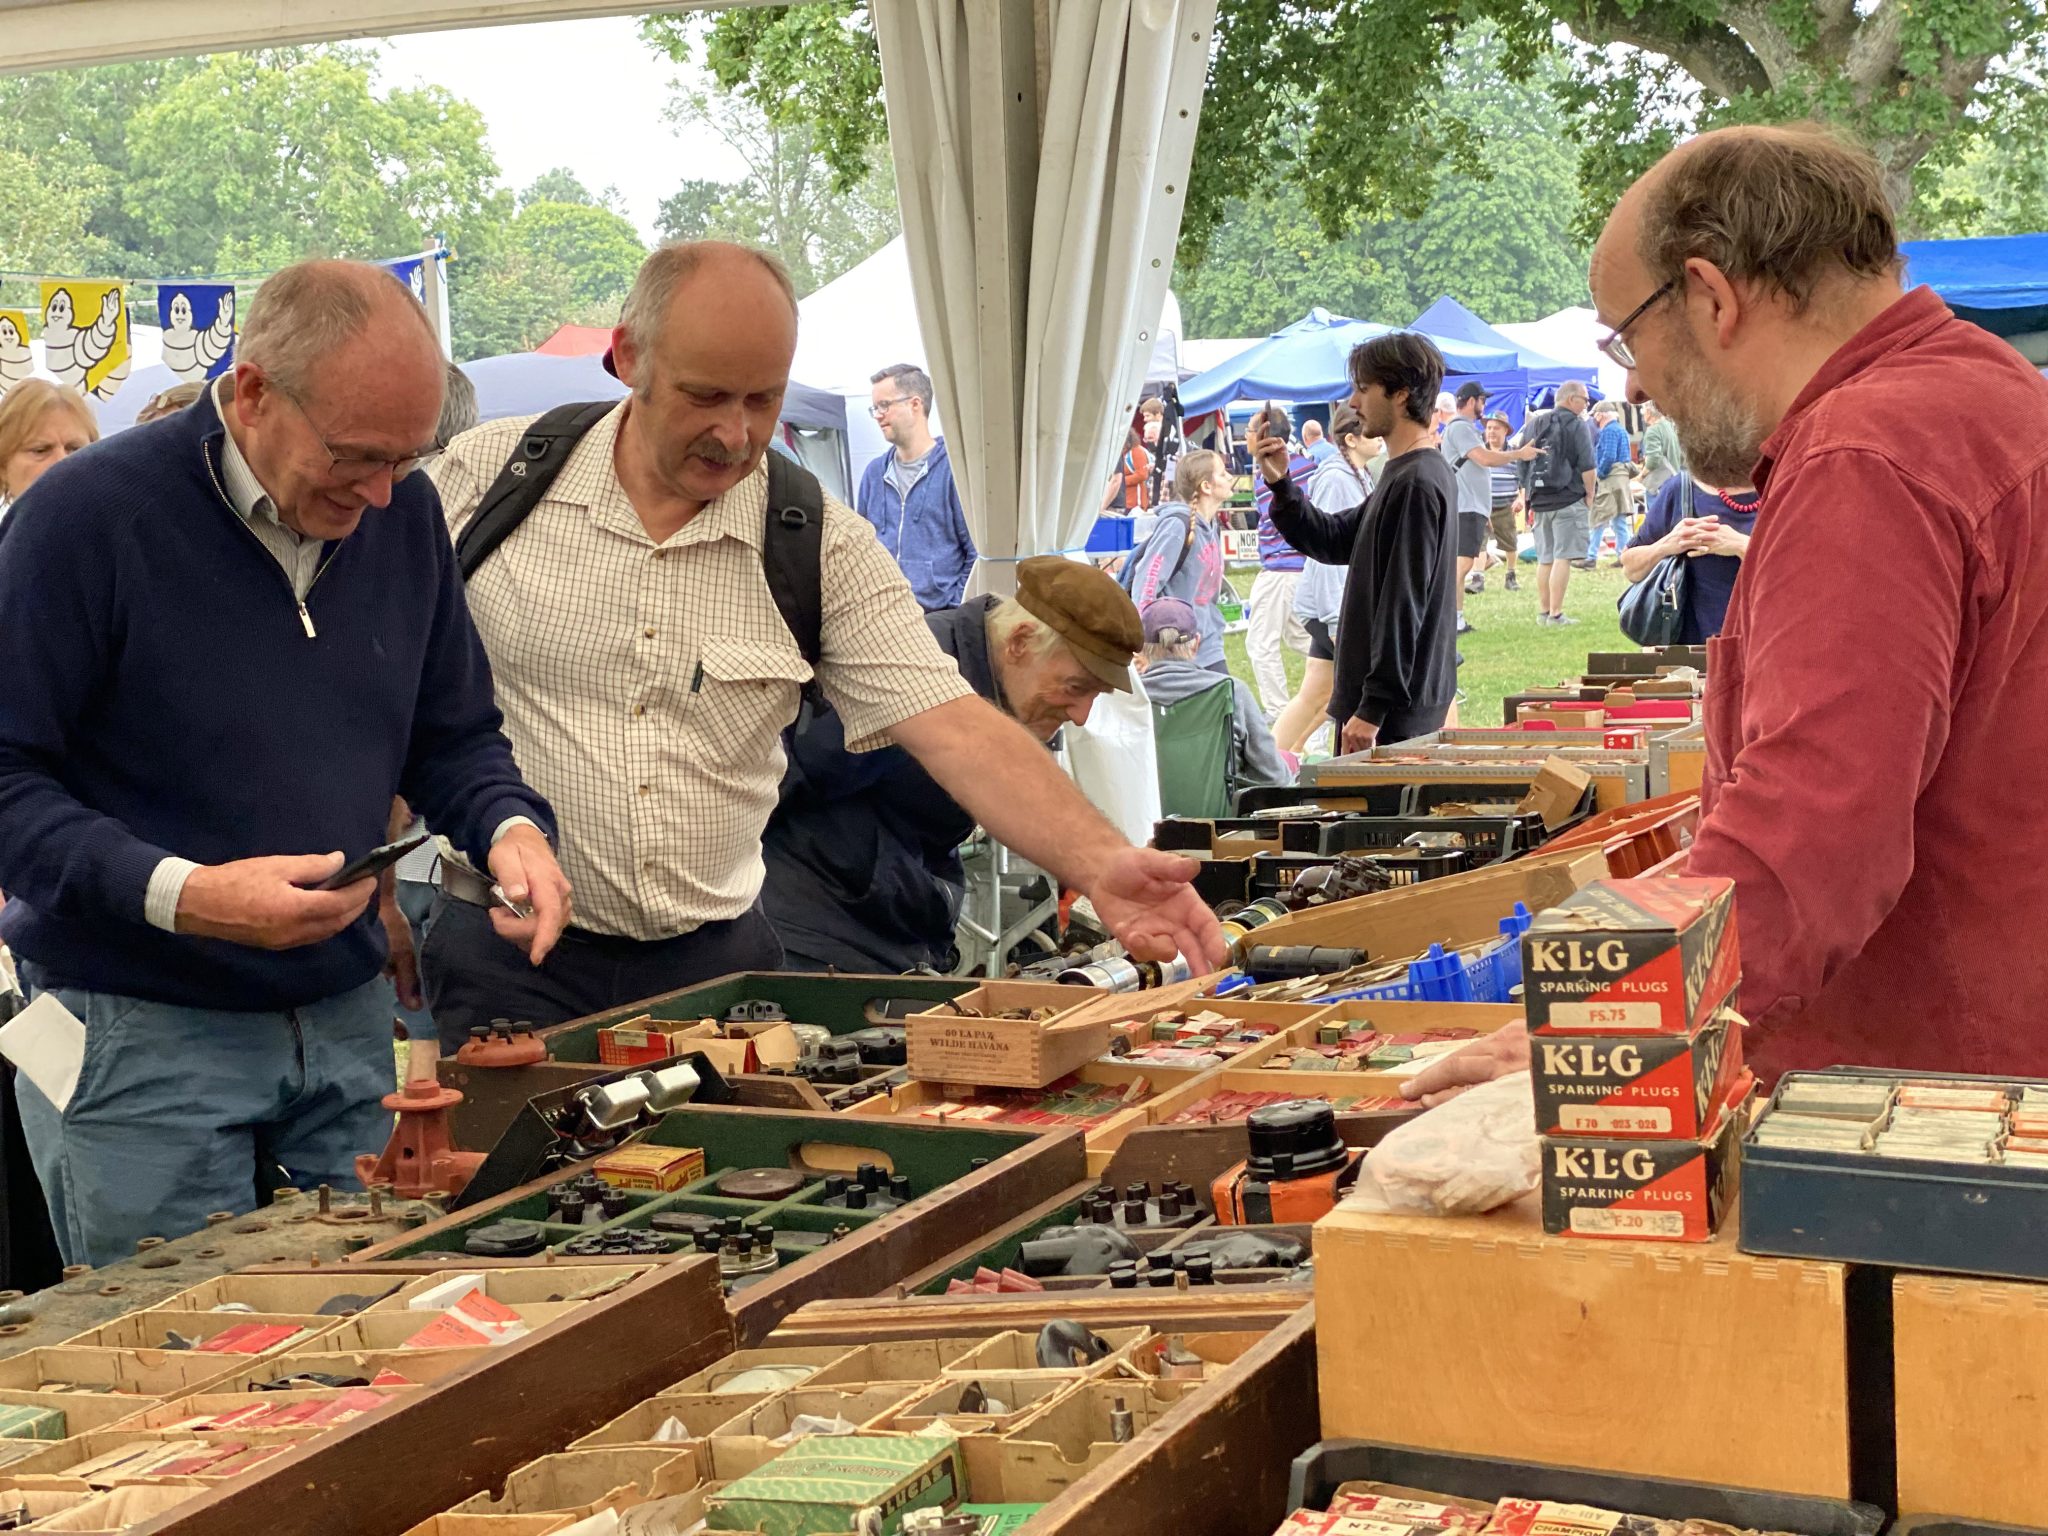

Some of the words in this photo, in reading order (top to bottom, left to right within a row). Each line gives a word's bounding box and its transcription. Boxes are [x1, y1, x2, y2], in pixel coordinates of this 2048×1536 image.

[1224, 535, 1236, 555] L
[1540, 981, 1612, 993] SPARKING
[1621, 981, 1669, 993] PLUGS
[930, 1038, 966, 1049] WILDE
[968, 1040, 1010, 1051] HAVANA
[1548, 1083, 1623, 1096] SPARKING
[1632, 1086, 1680, 1097] PLUGS
[1560, 1187, 1635, 1199] SPARKING
[1644, 1190, 1693, 1202] PLUGS
[886, 1464, 943, 1516] LUCAS
[1534, 1524, 1603, 1536] CHAMPION
